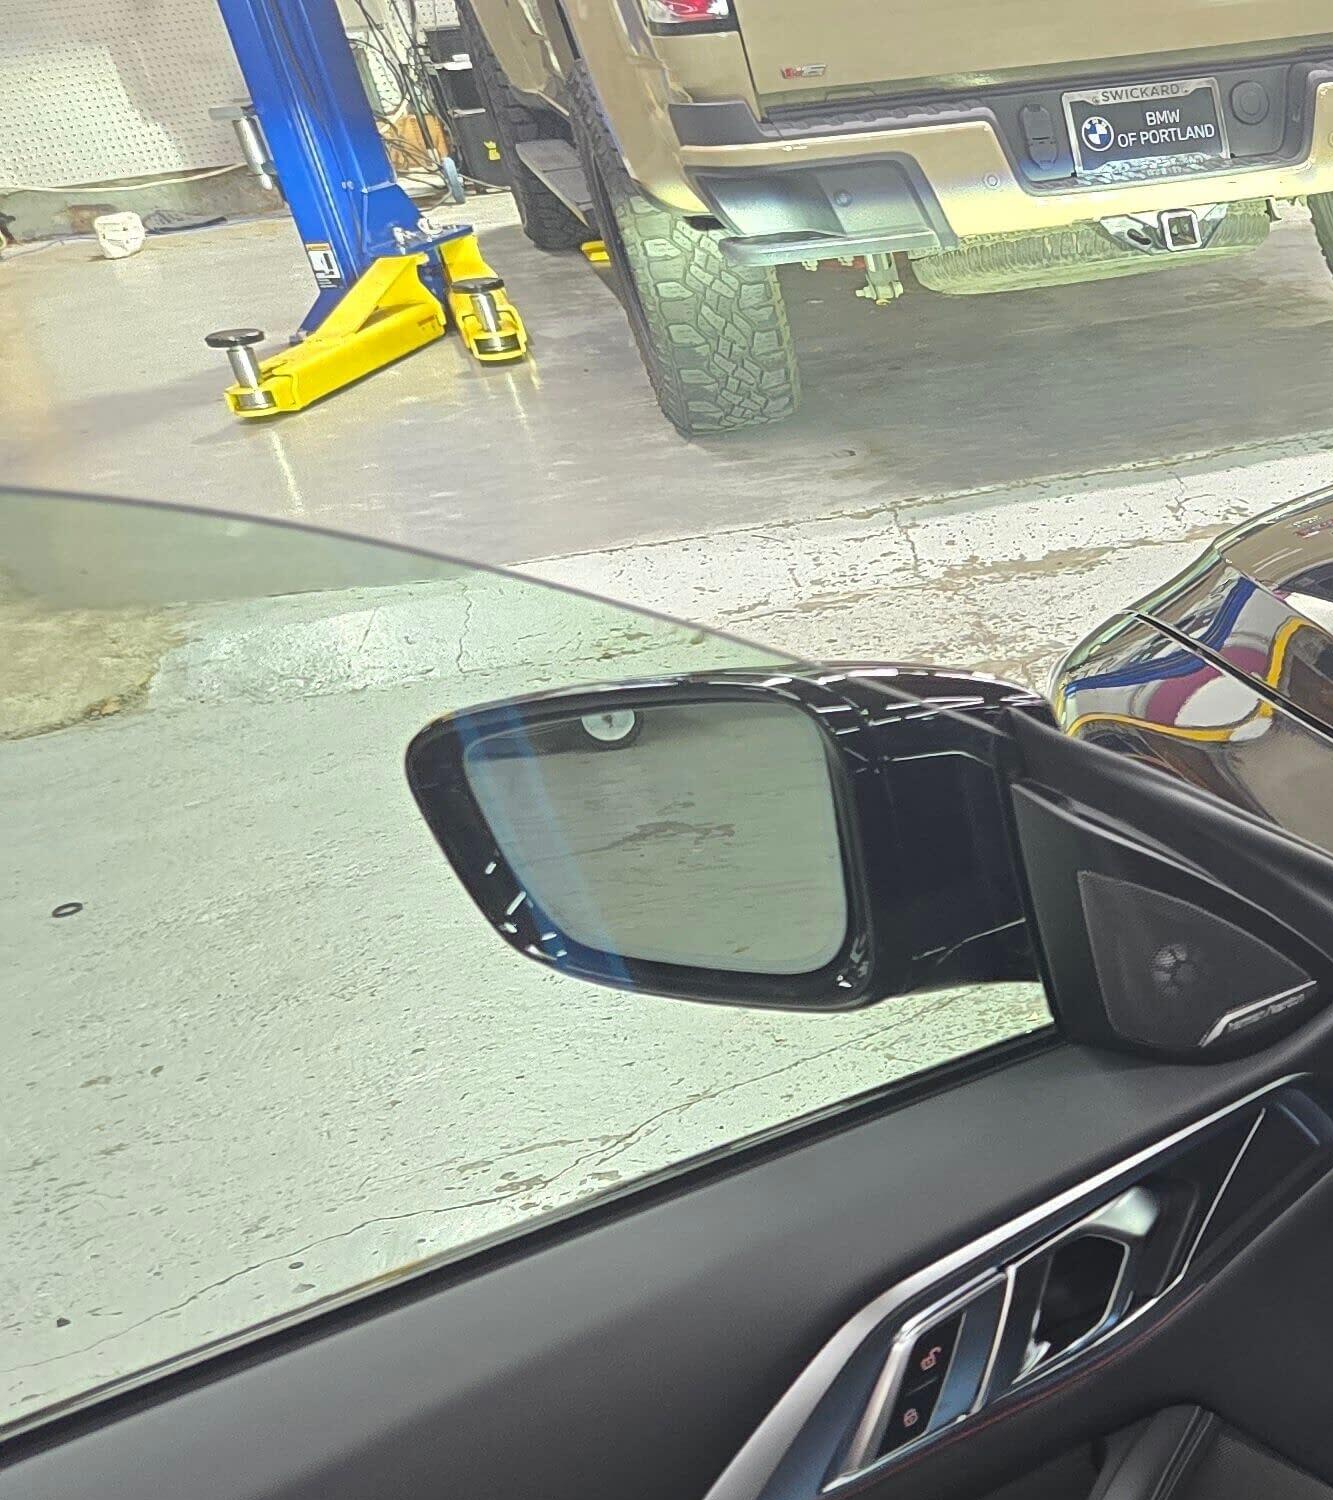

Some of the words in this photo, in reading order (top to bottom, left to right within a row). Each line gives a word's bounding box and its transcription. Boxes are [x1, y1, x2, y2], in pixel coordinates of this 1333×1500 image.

[1101, 84, 1180, 102] SWICKARD
[1145, 109, 1180, 126] BMW
[1117, 133, 1136, 148] OF
[1140, 123, 1215, 145] PORTLAND
